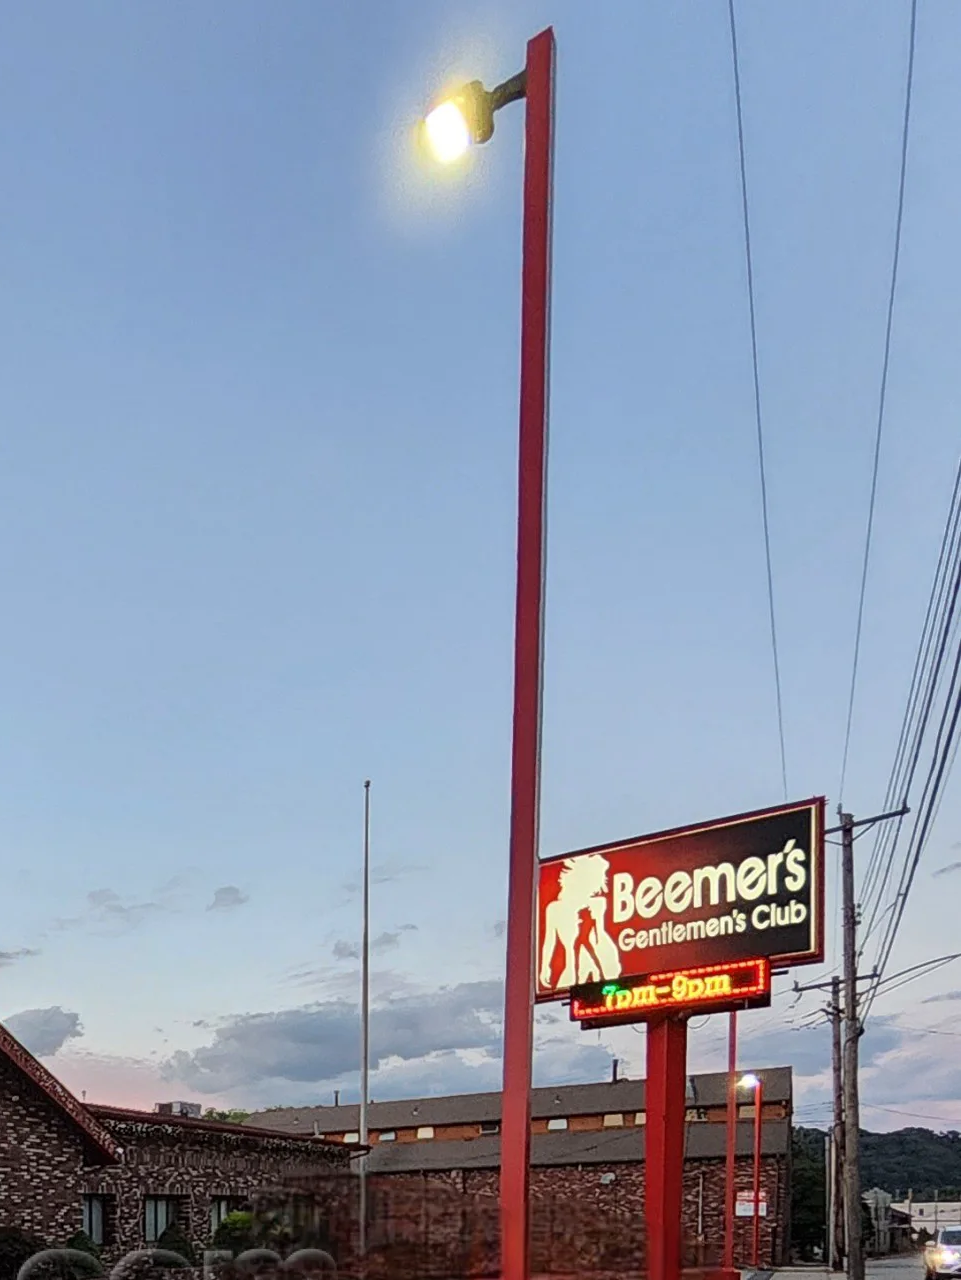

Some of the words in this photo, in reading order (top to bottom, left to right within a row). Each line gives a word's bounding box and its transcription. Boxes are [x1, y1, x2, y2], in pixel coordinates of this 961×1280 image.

[613, 839, 806, 923] Beemer's
[618, 909, 746, 951] Gentlemen's
[751, 900, 807, 930] Club
